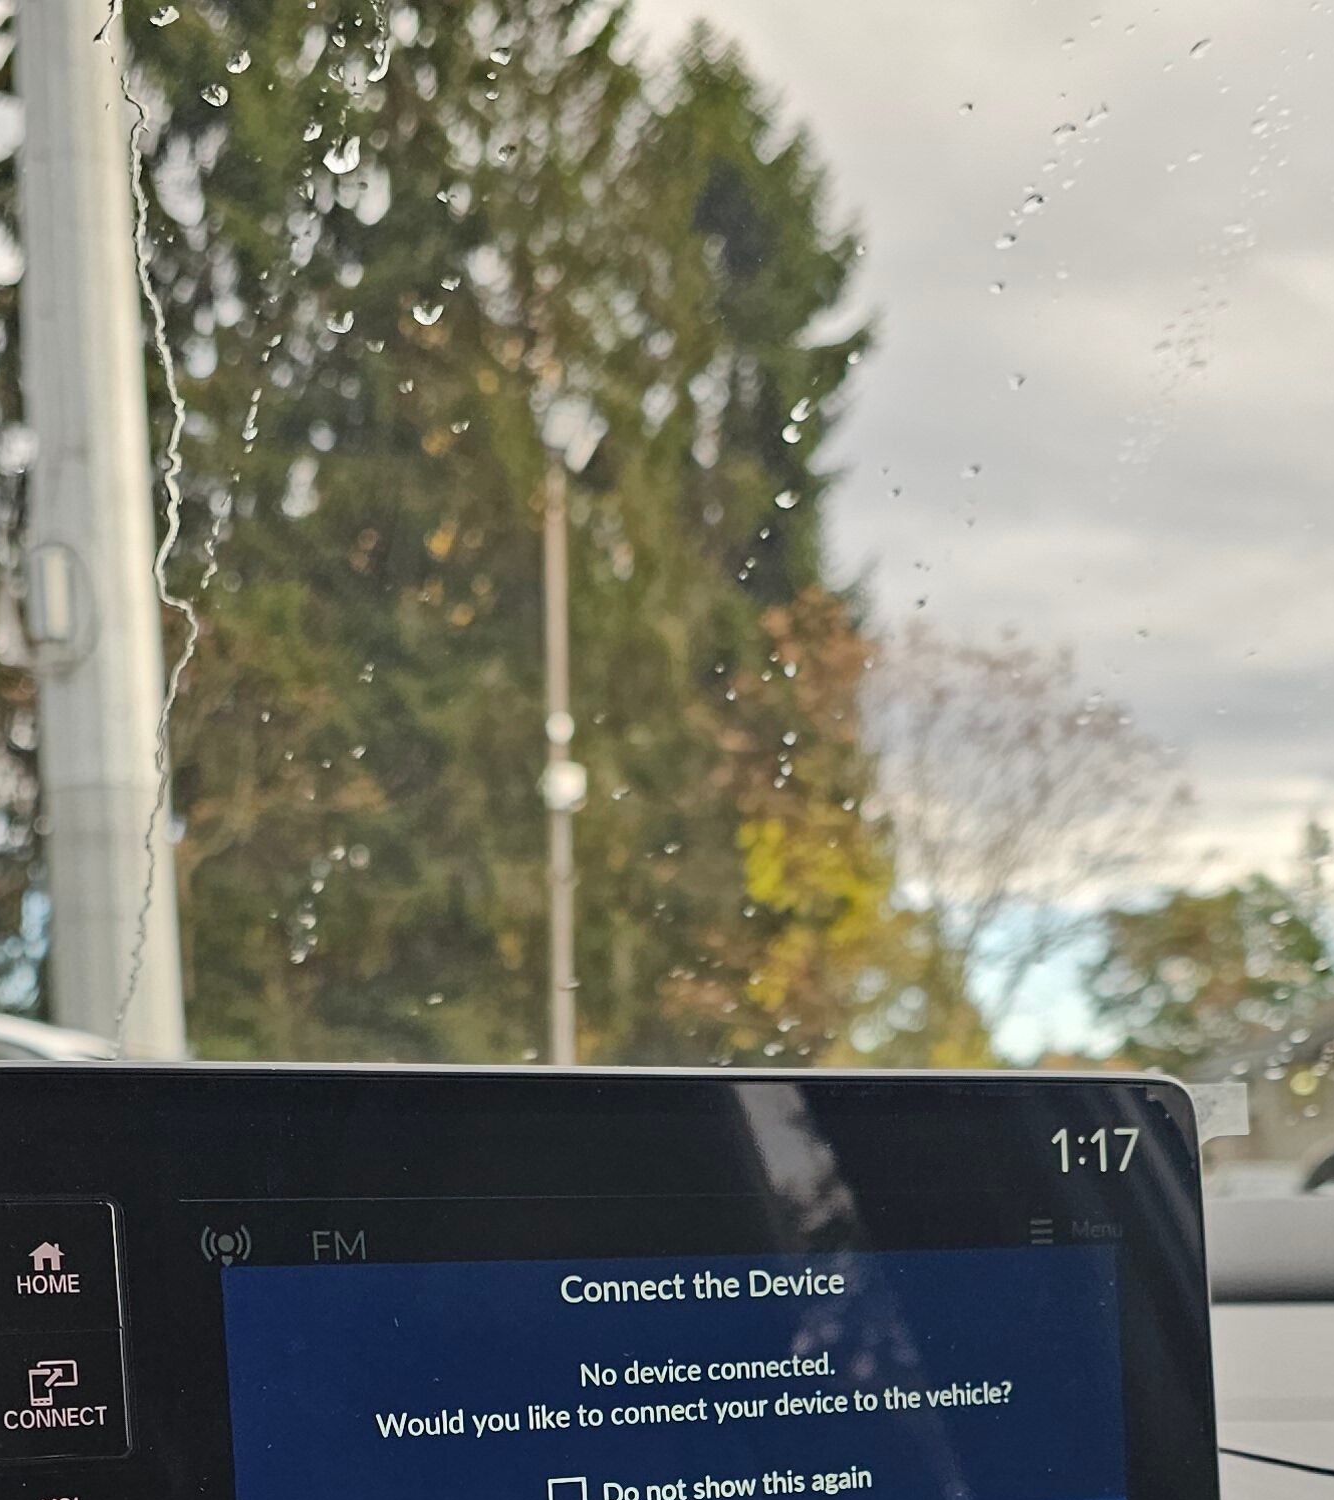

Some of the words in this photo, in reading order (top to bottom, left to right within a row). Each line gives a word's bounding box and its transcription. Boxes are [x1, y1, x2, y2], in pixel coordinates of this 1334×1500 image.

[1051, 1127, 1140, 1173] 1:17
[312, 1230, 366, 1261] FM
[1072, 1218, 1124, 1239] Menu
[16, 1273, 81, 1295] HOME
[560, 1273, 686, 1304] Connect
[692, 1270, 740, 1299] the
[748, 1267, 845, 1298] Device
[580, 1362, 618, 1388] No
[624, 1358, 702, 1385] device
[707, 1351, 836, 1381] connected.
[3, 1405, 108, 1430] CONNECT
[375, 1408, 465, 1439] Would
[471, 1412, 520, 1439] you
[528, 1404, 571, 1431] like
[576, 1404, 604, 1428] to
[610, 1397, 708, 1426] connect
[713, 1399, 769, 1425] your
[774, 1389, 849, 1416] device
[853, 1389, 879, 1412] to
[883, 1385, 921, 1410] the
[925, 1380, 1012, 1408] vehicle?
[693, 1474, 757, 1500] show
[761, 1469, 806, 1495] this
[811, 1465, 873, 1495] again
